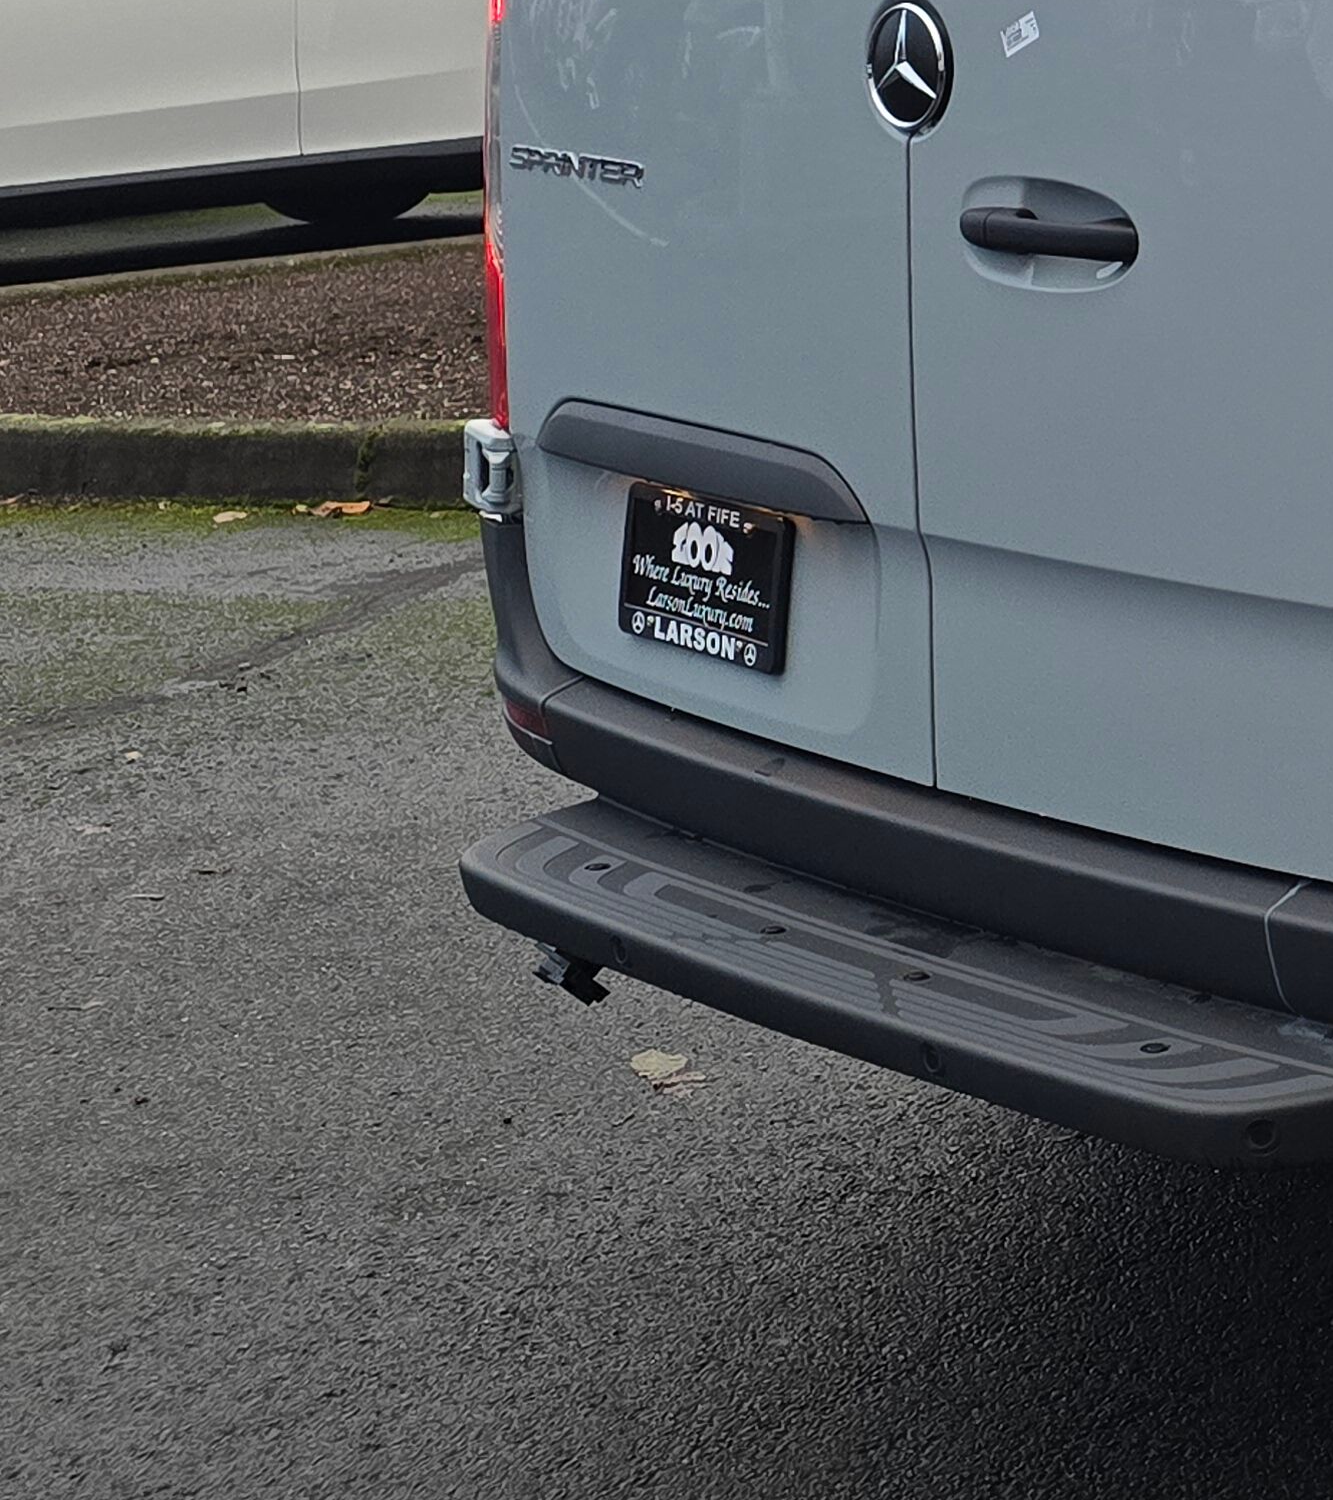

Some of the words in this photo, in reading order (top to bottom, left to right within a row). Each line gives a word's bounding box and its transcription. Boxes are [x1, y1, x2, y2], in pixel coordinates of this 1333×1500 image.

[509, 144, 644, 188] SPRINTER
[684, 501, 705, 519] AT
[707, 505, 740, 528] FIFE
[632, 553, 670, 583] Where
[671, 564, 713, 602] Luxury
[653, 616, 736, 660] LARSON
